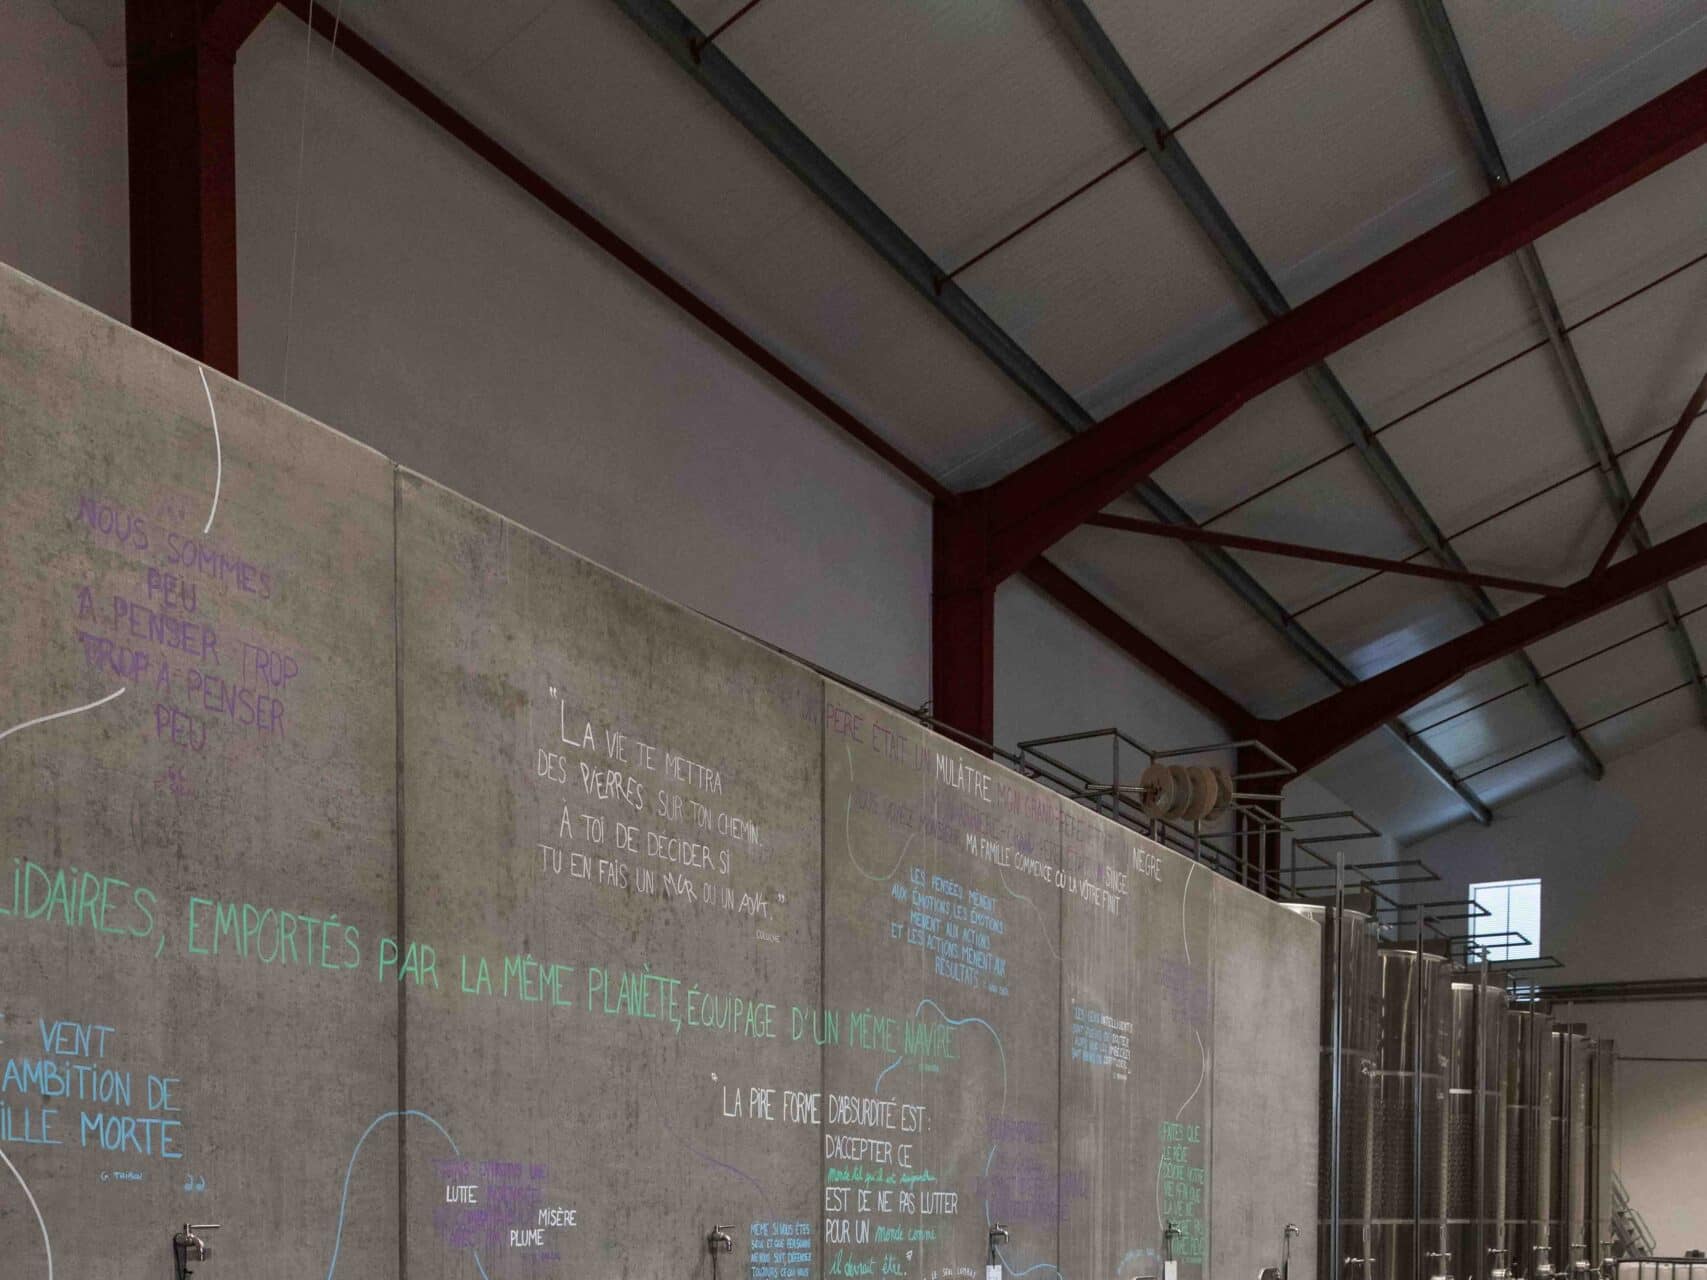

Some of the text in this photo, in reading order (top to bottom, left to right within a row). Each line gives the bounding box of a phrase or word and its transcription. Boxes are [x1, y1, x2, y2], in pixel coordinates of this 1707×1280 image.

[79, 500, 271, 599] NOUS SOMMES
[147, 567, 197, 613] PEU
[113, 596, 220, 665] PENSER
[241, 643, 299, 690] TROP
[77, 631, 285, 737] TROP A PENSER
[155, 704, 207, 750] PEU
[606, 730, 627, 763] VIE
[636, 742, 656, 771] TE
[665, 753, 722, 795] METTRA
[936, 752, 992, 802] MULÂTRE
[537, 748, 567, 784] DES
[580, 762, 643, 810] PIERRES
[658, 790, 683, 826] SUR
[689, 800, 711, 830] TON
[581, 814, 604, 844] TOI
[616, 822, 640, 853] DE
[719, 850, 730, 874] SI
[966, 833, 977, 856] MA
[981, 840, 1011, 867] FAMILLE
[1014, 851, 1052, 882] COMMENCE
[1069, 880, 1077, 893] LA
[538, 843, 562, 875] TU
[570, 853, 591, 880] EN
[599, 859, 628, 889] FAIS
[636, 867, 654, 896] UN
[663, 872, 697, 903] MUR
[703, 882, 716, 904] OU
[721, 885, 734, 909] UN
[0, 858, 165, 957] IDAIRES,
[189, 896, 359, 969] EMPORTÉS
[379, 937, 438, 989] PAR
[462, 954, 492, 996] LA
[504, 953, 574, 1006] MÊME
[687, 983, 776, 1038] ÉQUIPAGE
[792, 1006, 839, 1045] D'UN
[850, 1008, 897, 1053] MÊME
[904, 1022, 960, 1059] NAVIRE
[39, 1018, 115, 1057] VENT
[2, 1058, 182, 1112] AMBITION DE
[750, 1088, 776, 1120] PIRE
[784, 1090, 821, 1124] FORME
[80, 1111, 183, 1159] MORTE
[825, 1134, 913, 1169] D'ACCEPTER CE
[446, 1185, 479, 1203] LUTTE
[538, 1206, 577, 1227] MISÈRE
[825, 1187, 958, 1215] EST DE NE PAS LUTTER
[510, 1229, 545, 1247] PLUME
[825, 1218, 850, 1244] POUR
[855, 1218, 870, 1244] UN
